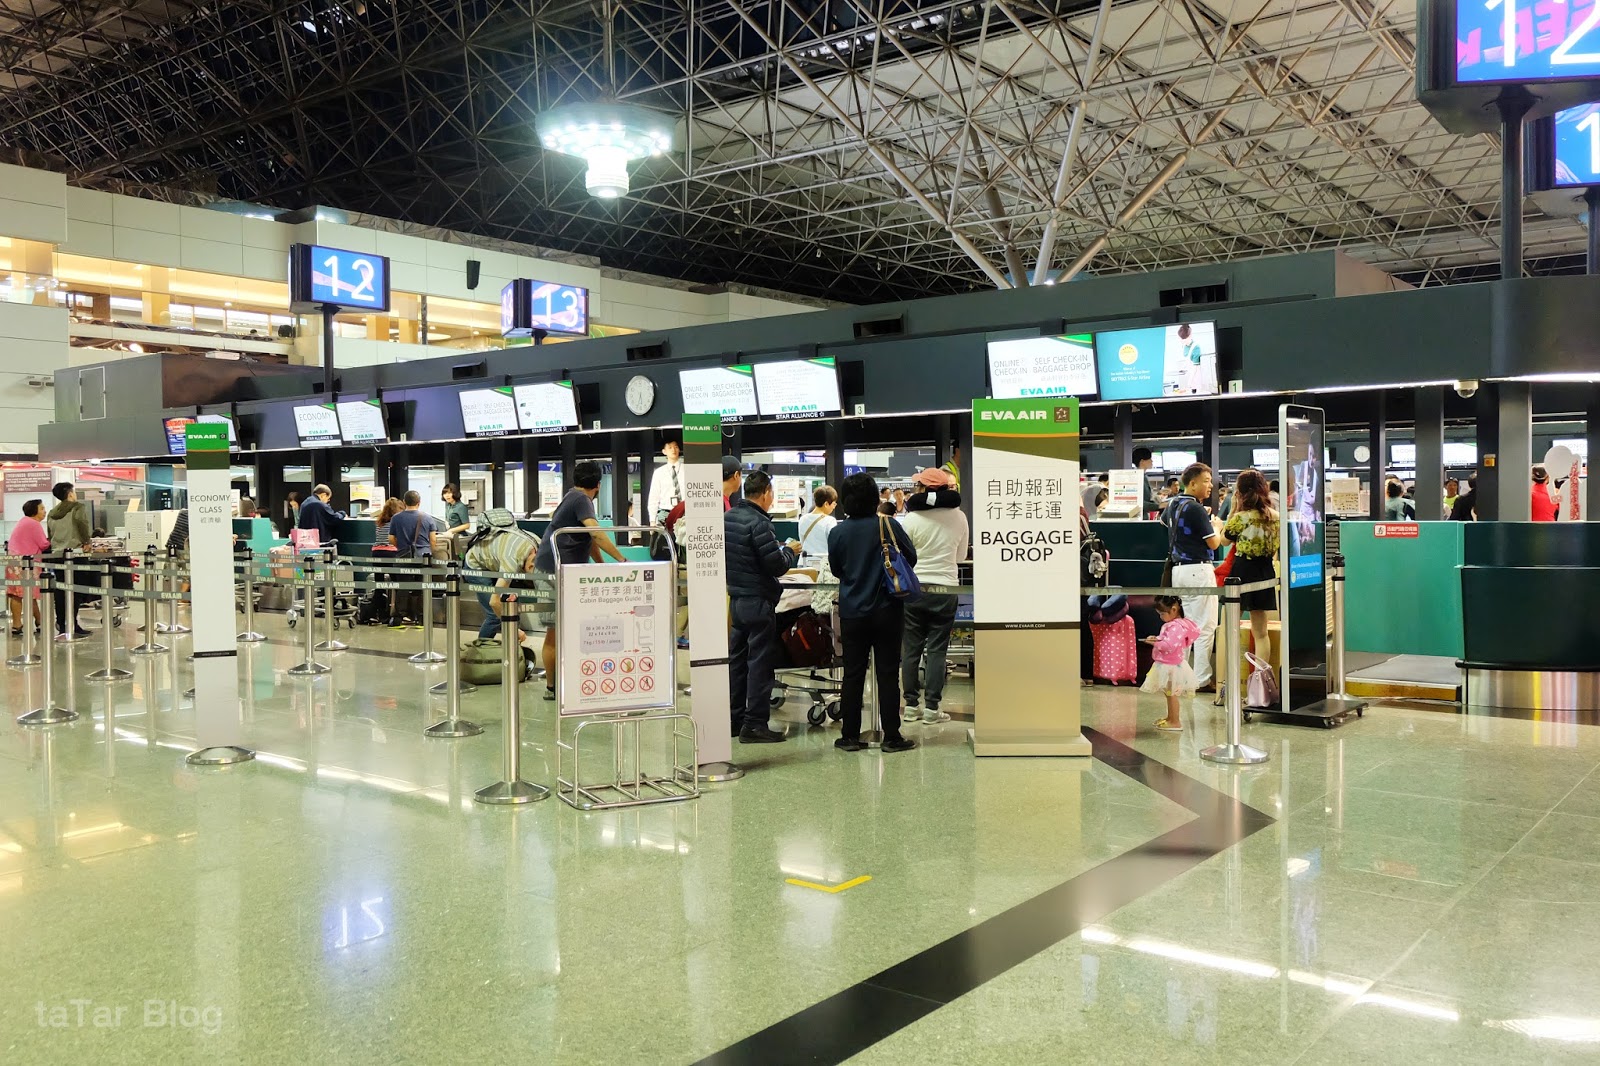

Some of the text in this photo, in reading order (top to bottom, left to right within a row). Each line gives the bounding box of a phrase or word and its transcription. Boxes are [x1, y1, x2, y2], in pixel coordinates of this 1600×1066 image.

[323, 255, 375, 301] 12
[541, 288, 579, 328] 13
[1232, 382, 1238, 393] 1
[686, 482, 714, 490] ONLINE
[987, 478, 1062, 497] 自助報到
[190, 494, 231, 502] ECONOMY
[686, 490, 722, 498] CHECK-IN
[986, 501, 1062, 519] 行李託運
[697, 526, 714, 534] SELF
[688, 534, 723, 542] CHECK-IN
[980, 530, 1073, 545] BAGGAGE
[687, 542, 724, 551] BAGGAGE
[695, 550, 717, 559] DROP
[1000, 548, 1054, 562] DROP
[580, 586, 643, 597] 手提行李須知
